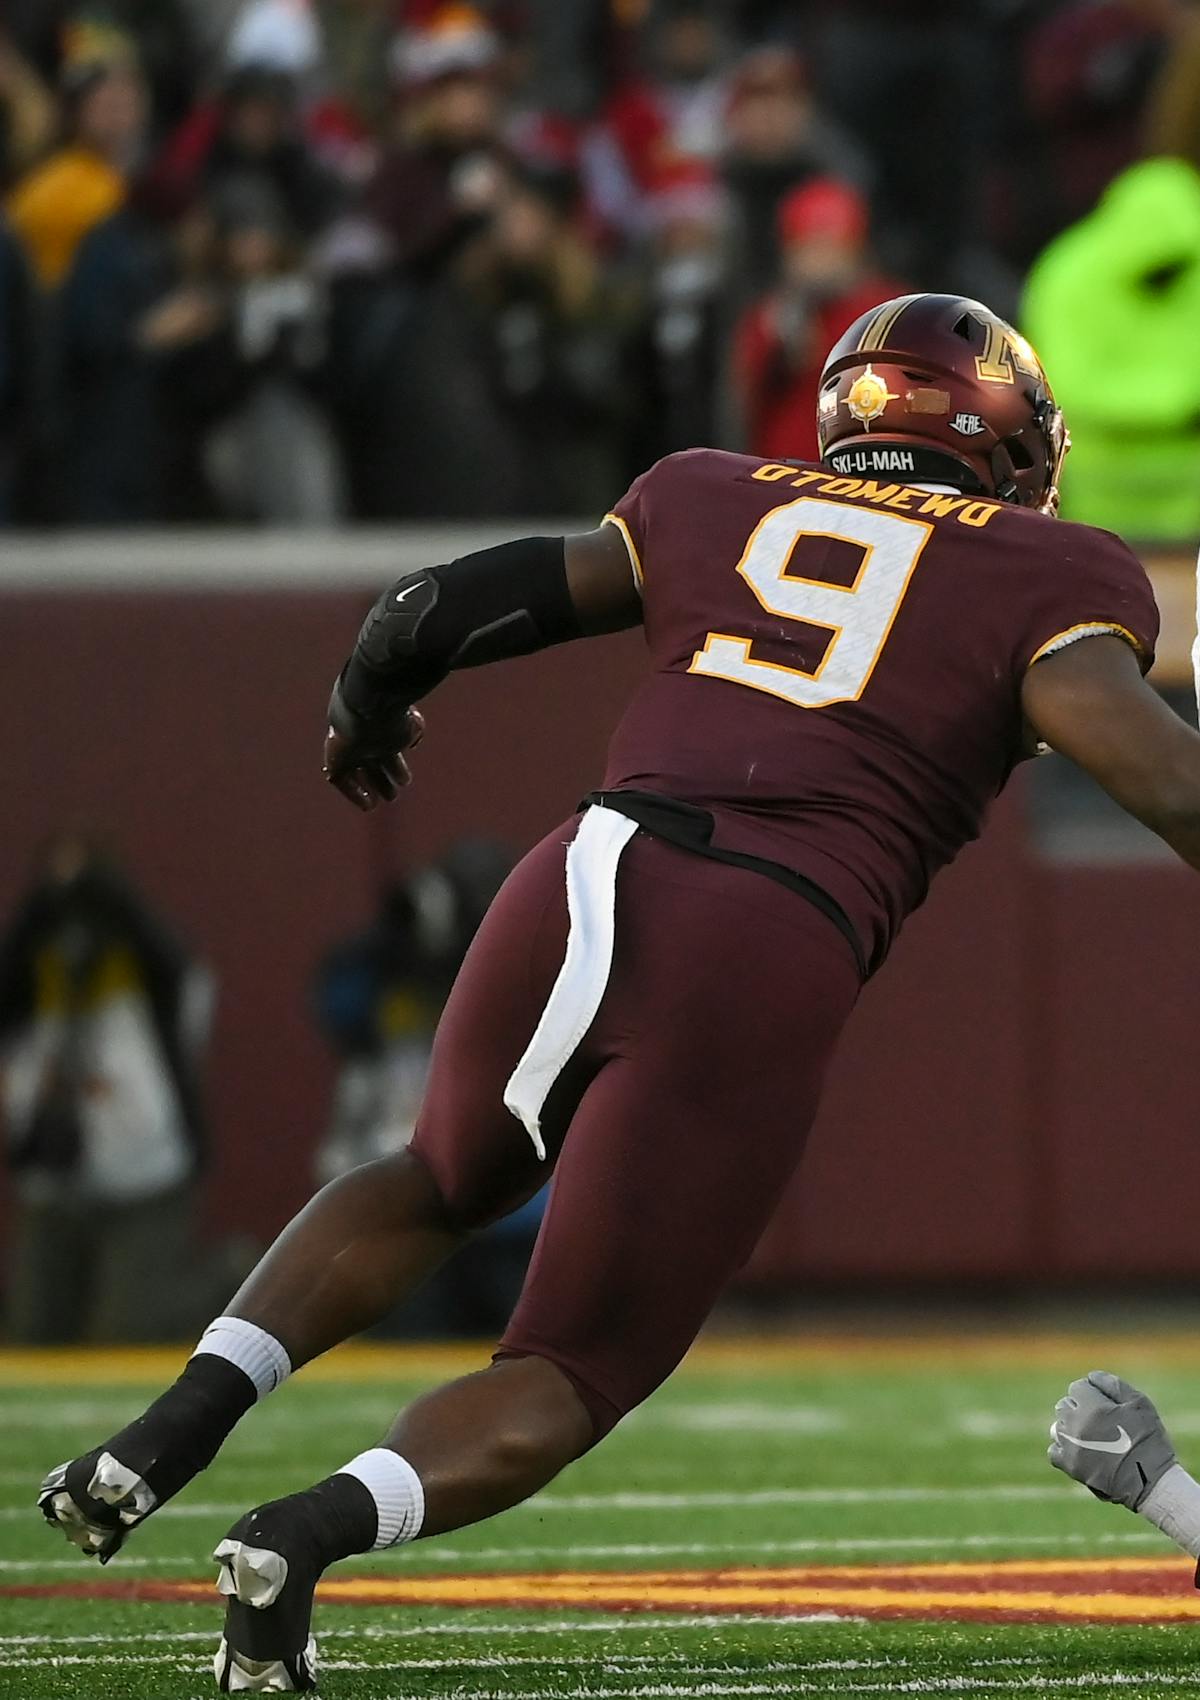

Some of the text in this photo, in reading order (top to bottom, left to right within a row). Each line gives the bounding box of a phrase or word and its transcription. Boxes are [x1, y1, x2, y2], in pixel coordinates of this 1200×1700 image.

[750, 462, 1004, 528] OTOMEWO
[831, 450, 915, 474] SKI-U-MAH
[686, 495, 937, 709] 9
